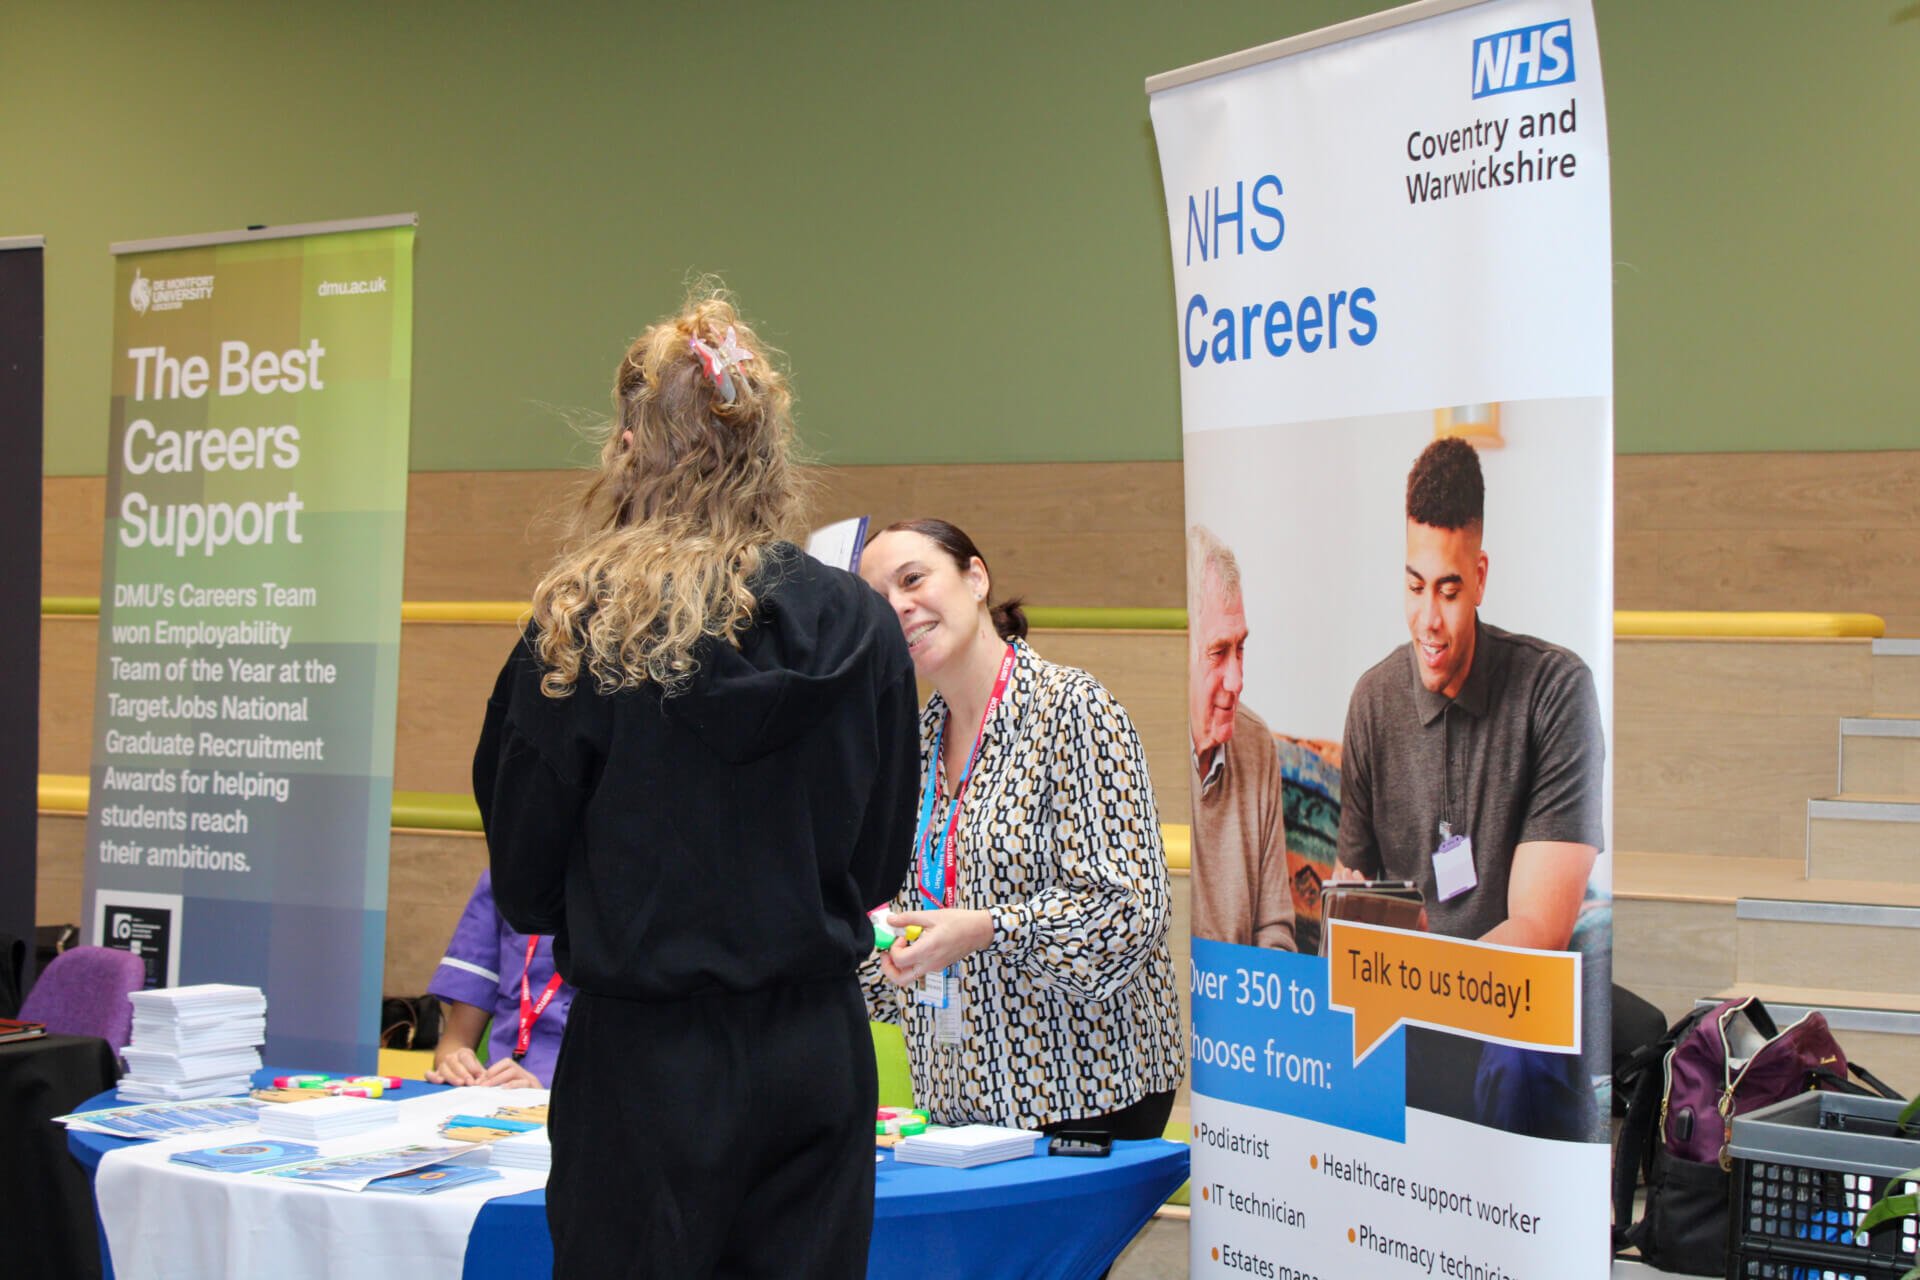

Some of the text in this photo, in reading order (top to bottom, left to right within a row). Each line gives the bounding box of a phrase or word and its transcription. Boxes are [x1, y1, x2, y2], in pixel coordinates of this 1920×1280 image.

[1474, 23, 1570, 95] NHS
[1406, 98, 1577, 162] Coventry and
[1405, 149, 1577, 205] Warwickshire
[1186, 174, 1286, 267] NHS
[153, 287, 214, 304] UNIVERSITY
[318, 276, 387, 297] dmu.ac.uk
[1184, 286, 1379, 369] Careers
[128, 338, 326, 402] The Best
[123, 419, 300, 475] Careers
[119, 492, 304, 557] Support
[114, 582, 317, 608] DMU's Careers Team
[112, 620, 292, 650] won Employability
[110, 656, 337, 684] Team of the Year at the
[999, 656, 1012, 682] VISITOR
[221, 695, 309, 722] National
[105, 729, 325, 761] Graduate Recruitment
[103, 766, 290, 803] Awards for helping
[101, 804, 249, 834] students reach
[99, 840, 252, 872] their ambitions.
[946, 835, 954, 868] VISITOR
[1235, 968, 1282, 1010] 350
[1288, 979, 1316, 1016] to
[1347, 949, 1533, 1019] Talk to us today!
[1190, 1022, 1332, 1090] hoose from:
[1200, 1122, 1270, 1160] Podiatrist
[1211, 1183, 1306, 1230] IT technician
[1323, 1152, 1541, 1235] Healthcare support worker
[1222, 1244, 1274, 1280] Estates
[1359, 1224, 1435, 1276] Pharmacy
